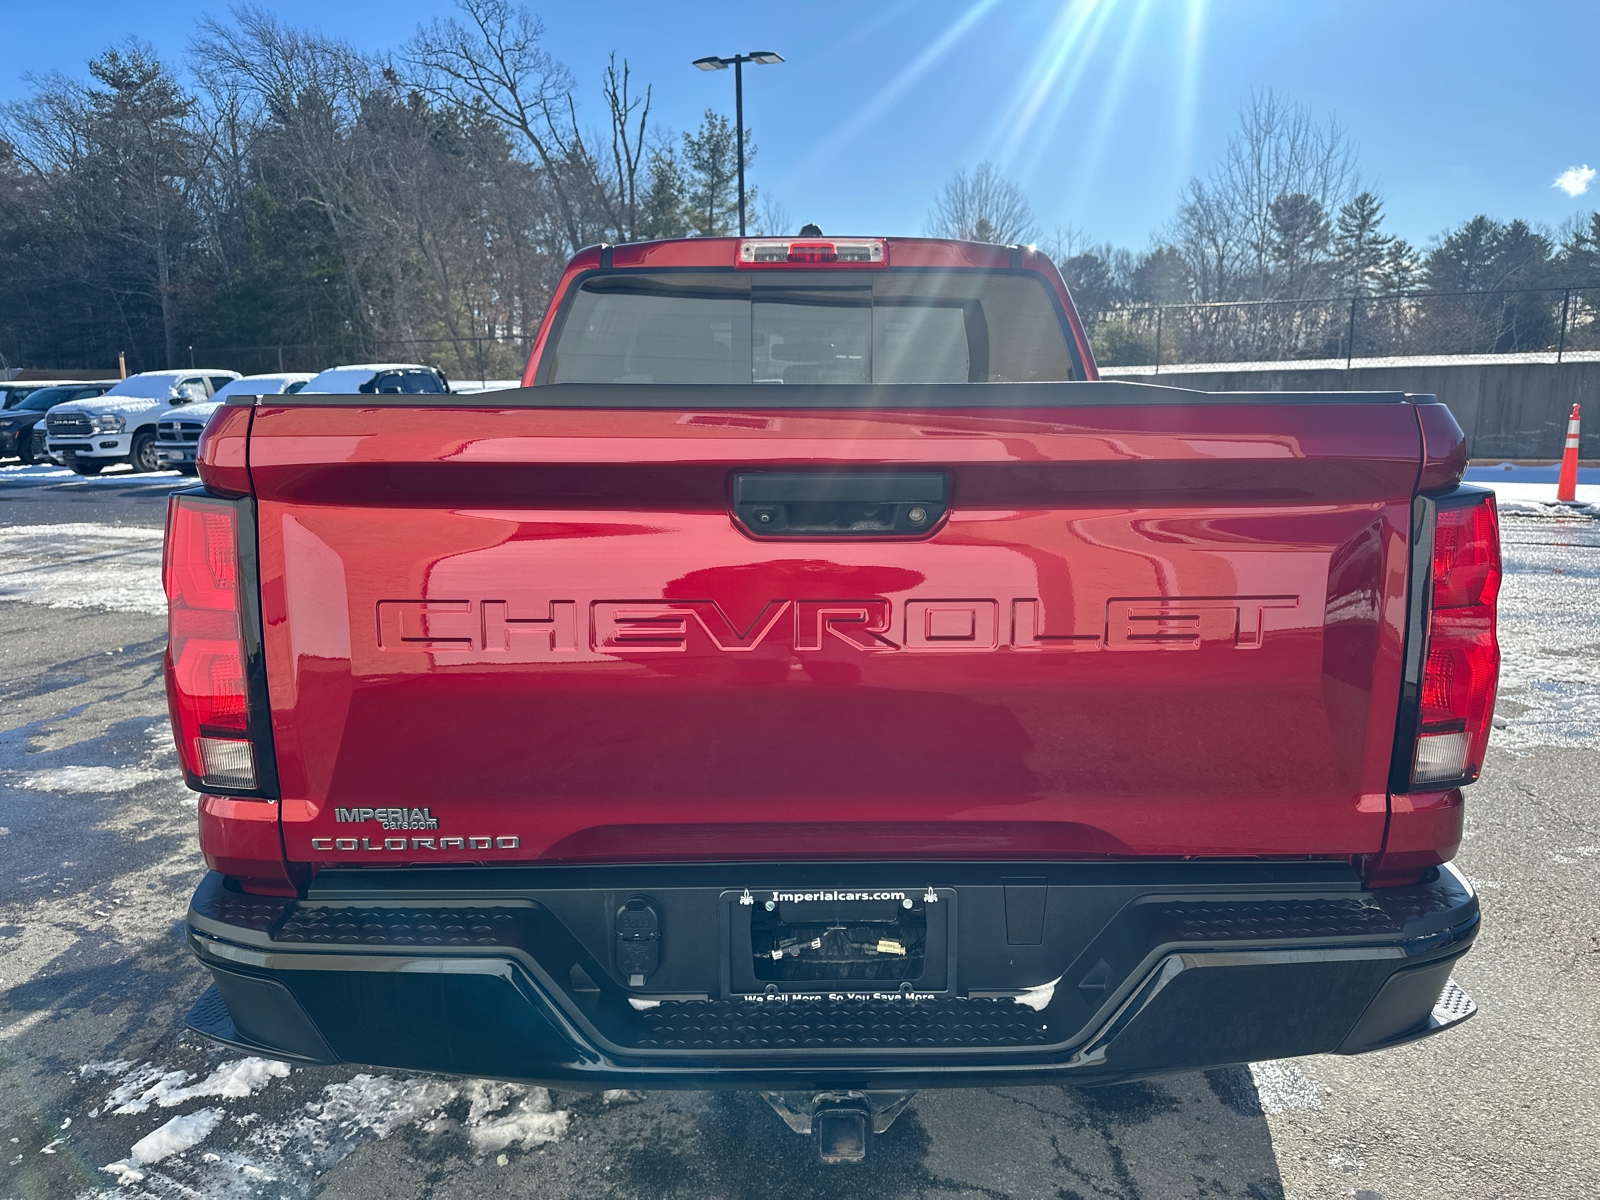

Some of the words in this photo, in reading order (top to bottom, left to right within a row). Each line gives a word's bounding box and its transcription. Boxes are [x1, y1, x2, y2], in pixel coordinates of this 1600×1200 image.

[375, 594, 1300, 653] CHEVROLET
[334, 807, 438, 822] IMPERIAL
[382, 821, 438, 830] cars.com
[311, 836, 521, 851] COLORADO
[772, 891, 905, 903] Imperialcars.com
[846, 993, 870, 1001] You
